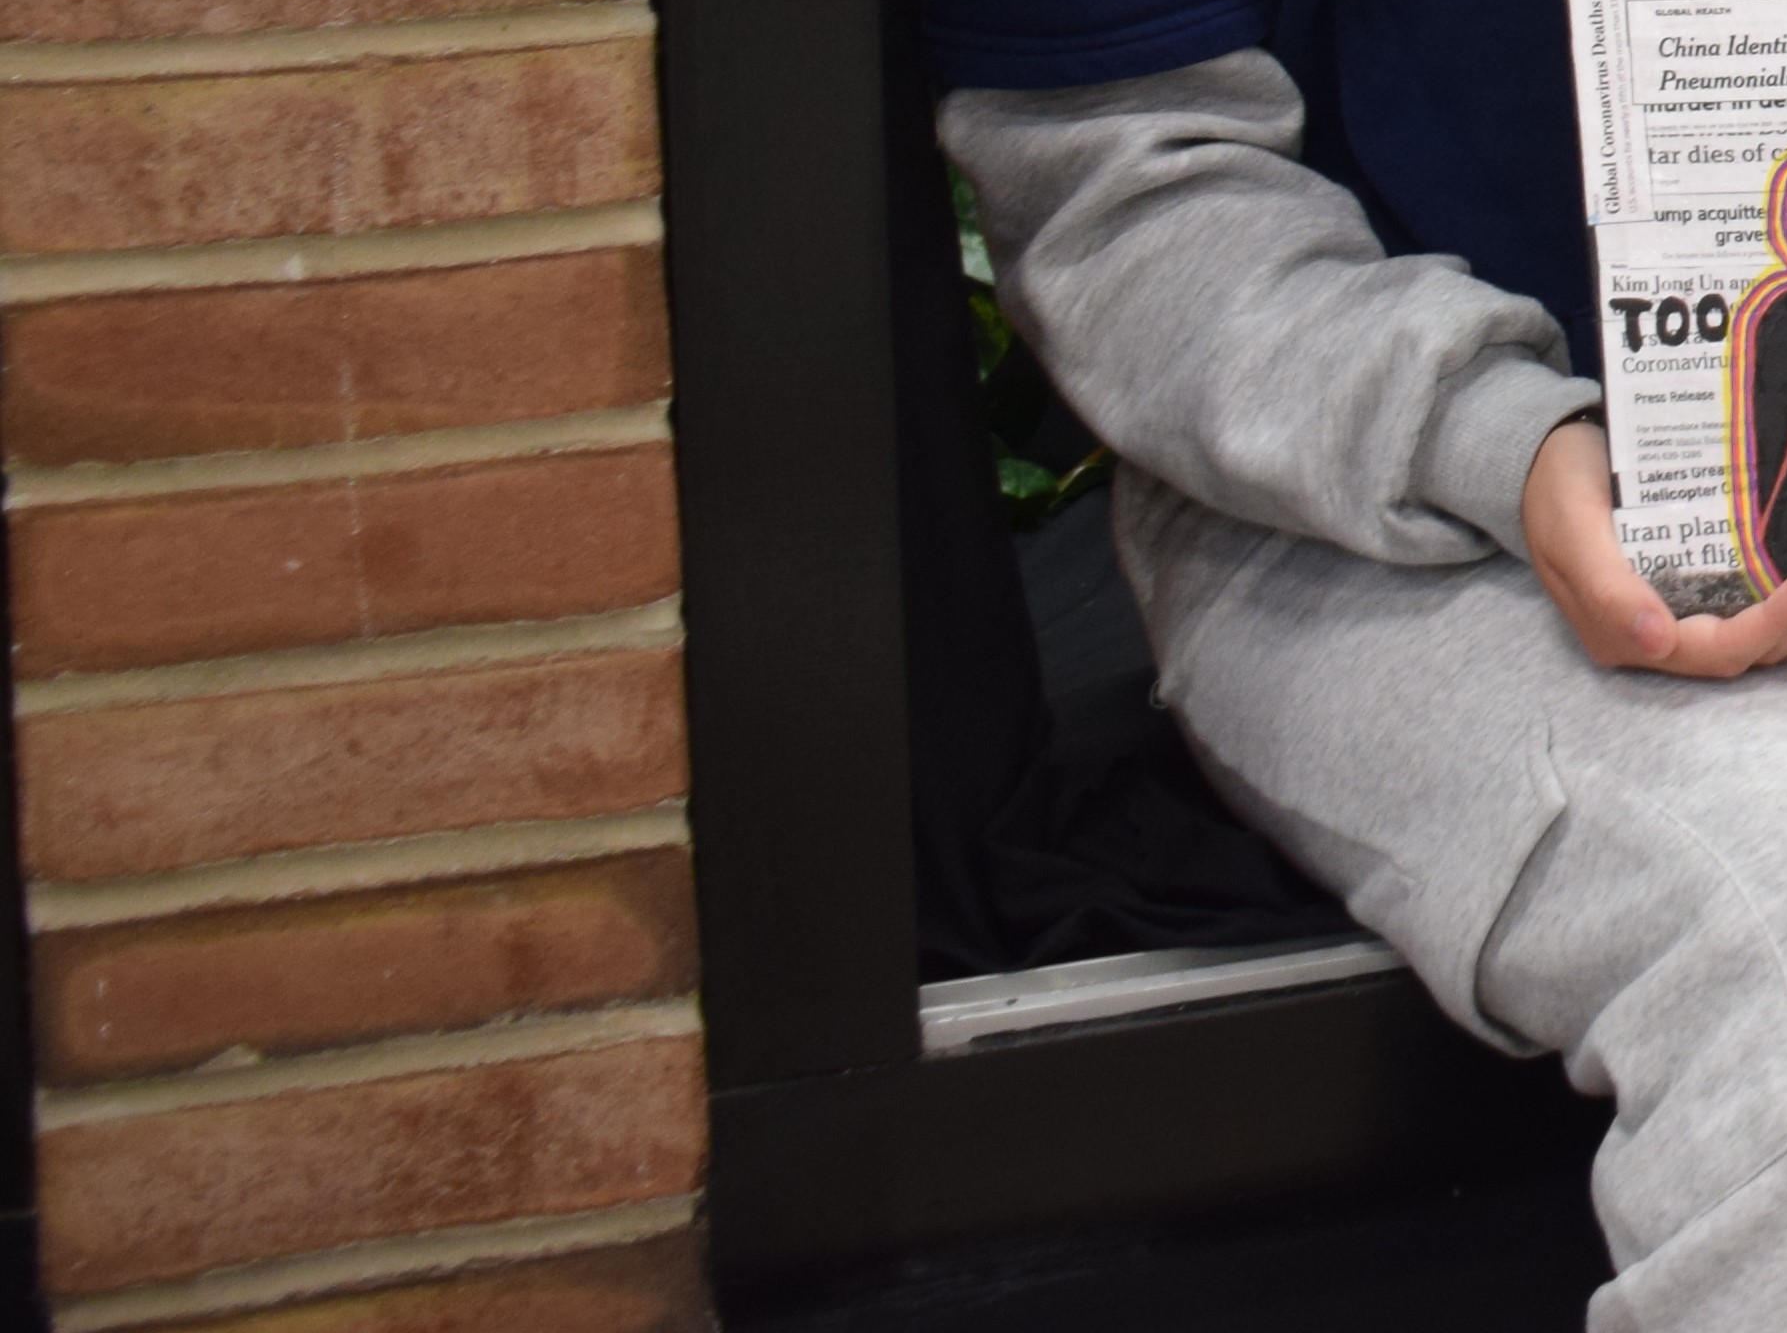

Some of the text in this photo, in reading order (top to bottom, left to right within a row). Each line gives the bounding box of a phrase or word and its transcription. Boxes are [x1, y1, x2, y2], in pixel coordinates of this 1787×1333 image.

[1588, 1, 1607, 56] Deaths
[1658, 36, 1722, 59] China
[1595, 61, 1616, 158] Coronavirus
[1687, 145, 1736, 164] dies
[1742, 142, 1765, 162] of
[1602, 162, 1621, 215] Global
[1697, 204, 1768, 224] acquitte
[1612, 275, 1648, 292] Kim
[1652, 275, 1694, 295] Jong
[1700, 274, 1725, 291] Un
[1608, 293, 1731, 353] TOO
[1621, 351, 1731, 374] Coronaviru
[1633, 389, 1716, 405] Press Release
[1638, 469, 1688, 485] Lakers
[1639, 484, 1718, 504] Helicopter
[1620, 516, 1732, 544] Iran plan
